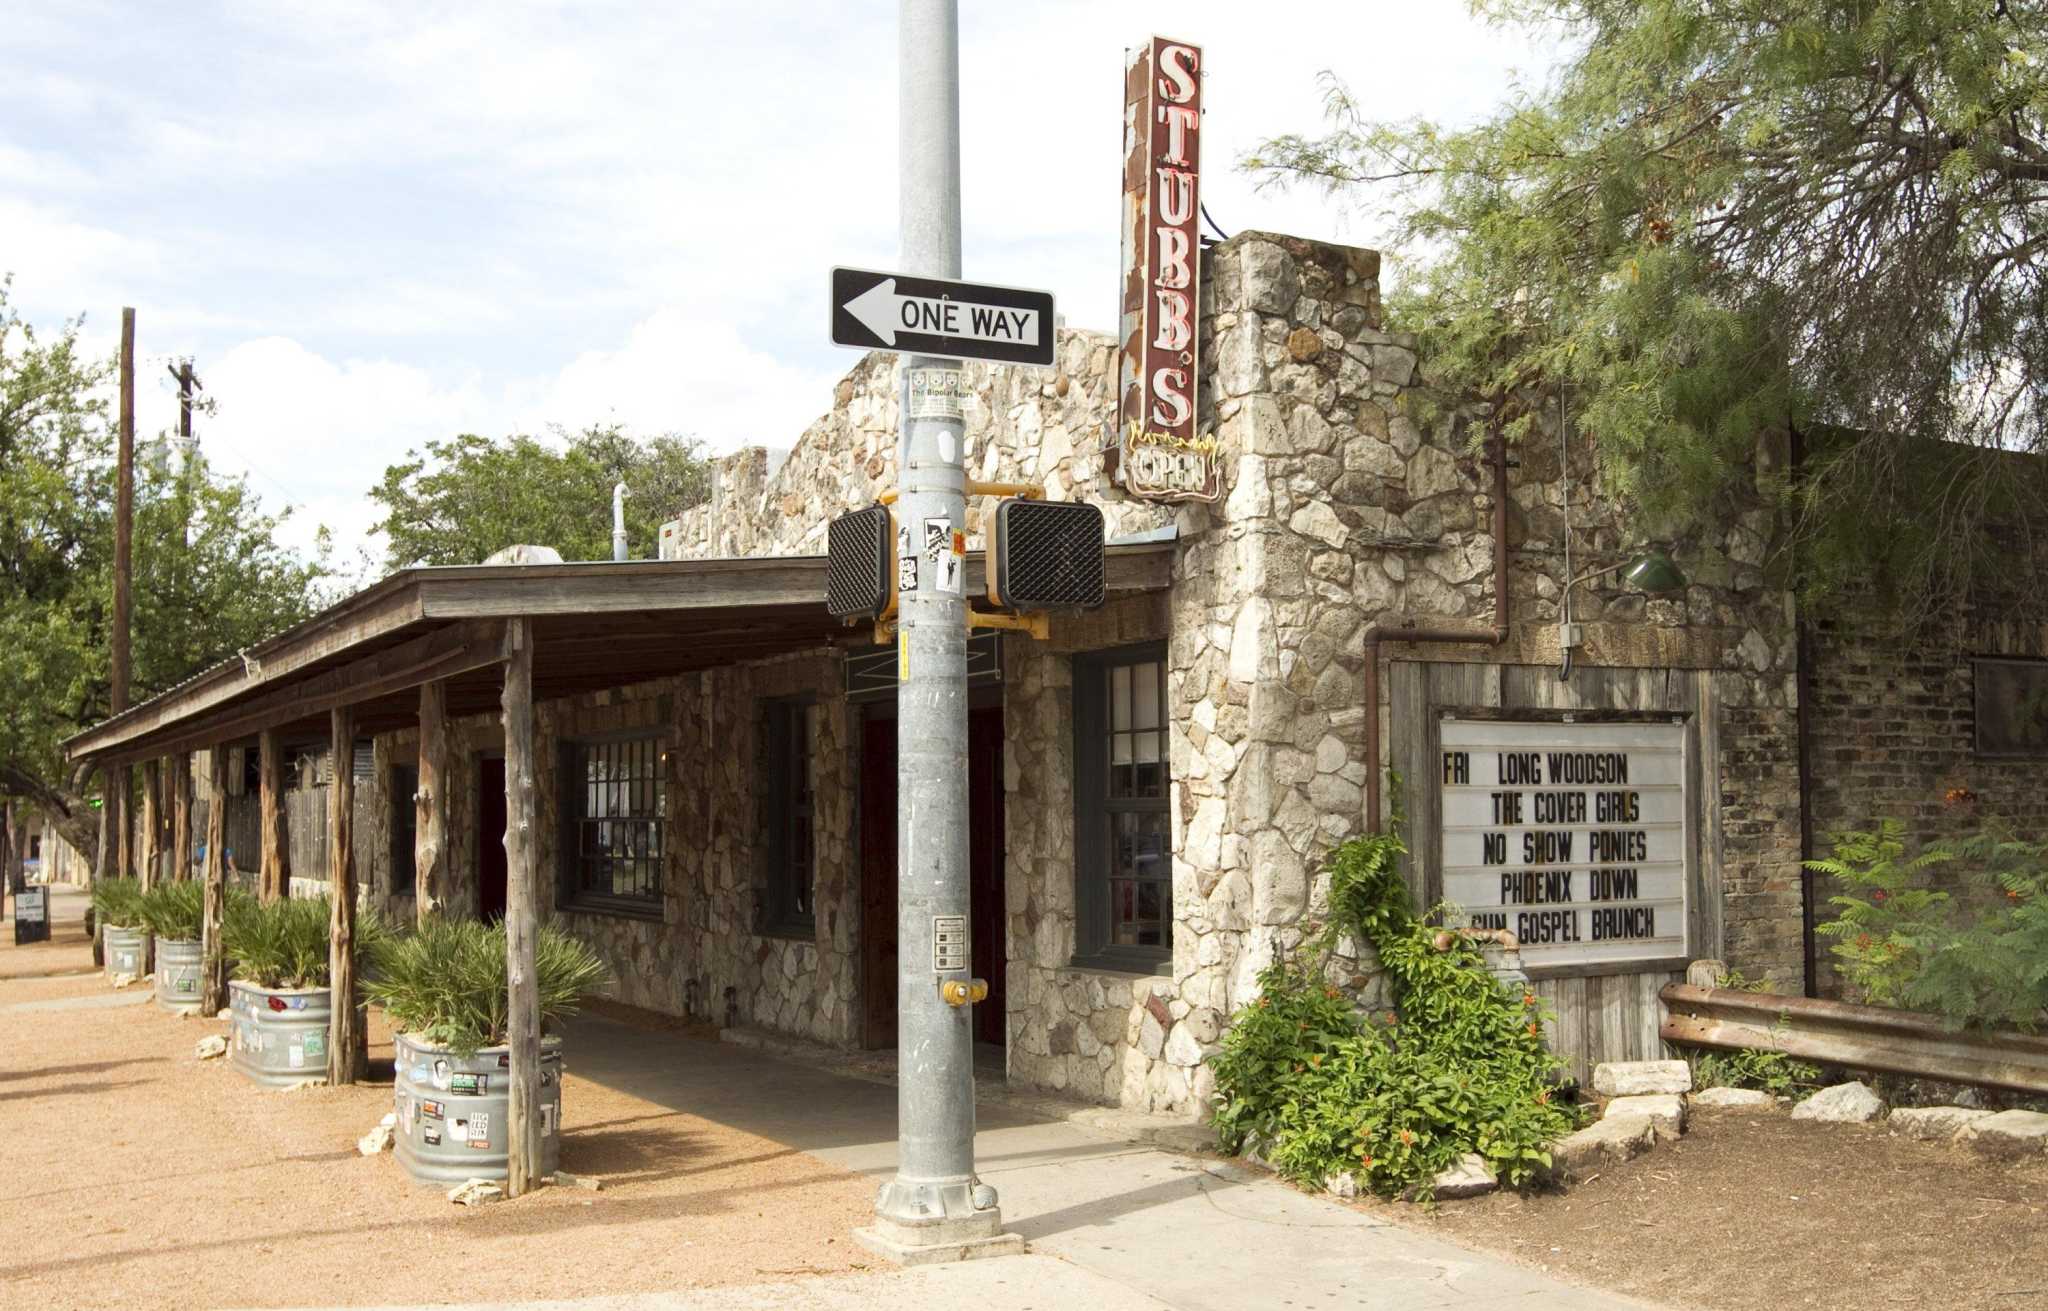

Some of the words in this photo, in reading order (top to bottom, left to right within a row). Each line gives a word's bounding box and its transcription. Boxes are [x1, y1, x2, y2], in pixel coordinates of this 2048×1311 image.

[901, 300, 960, 333] ONE
[971, 307, 1030, 340] WAY
[1133, 450, 1206, 491] OPEN
[1443, 752, 1470, 784] FRI
[1498, 753, 1541, 785] LONG
[1548, 753, 1628, 784] WOODSON
[1491, 792, 1523, 824] THE
[1534, 792, 1586, 824] COVER
[1596, 791, 1640, 824] GIRLS
[1483, 832, 1507, 864] NO
[1523, 831, 1572, 864] SHOW
[1590, 830, 1646, 863] PONIES
[1501, 871, 1572, 904] PHOENIX
[1590, 869, 1638, 901] DOWN
[1518, 910, 1580, 944] GOSPEL
[1592, 908, 1655, 941] BRUNCH
